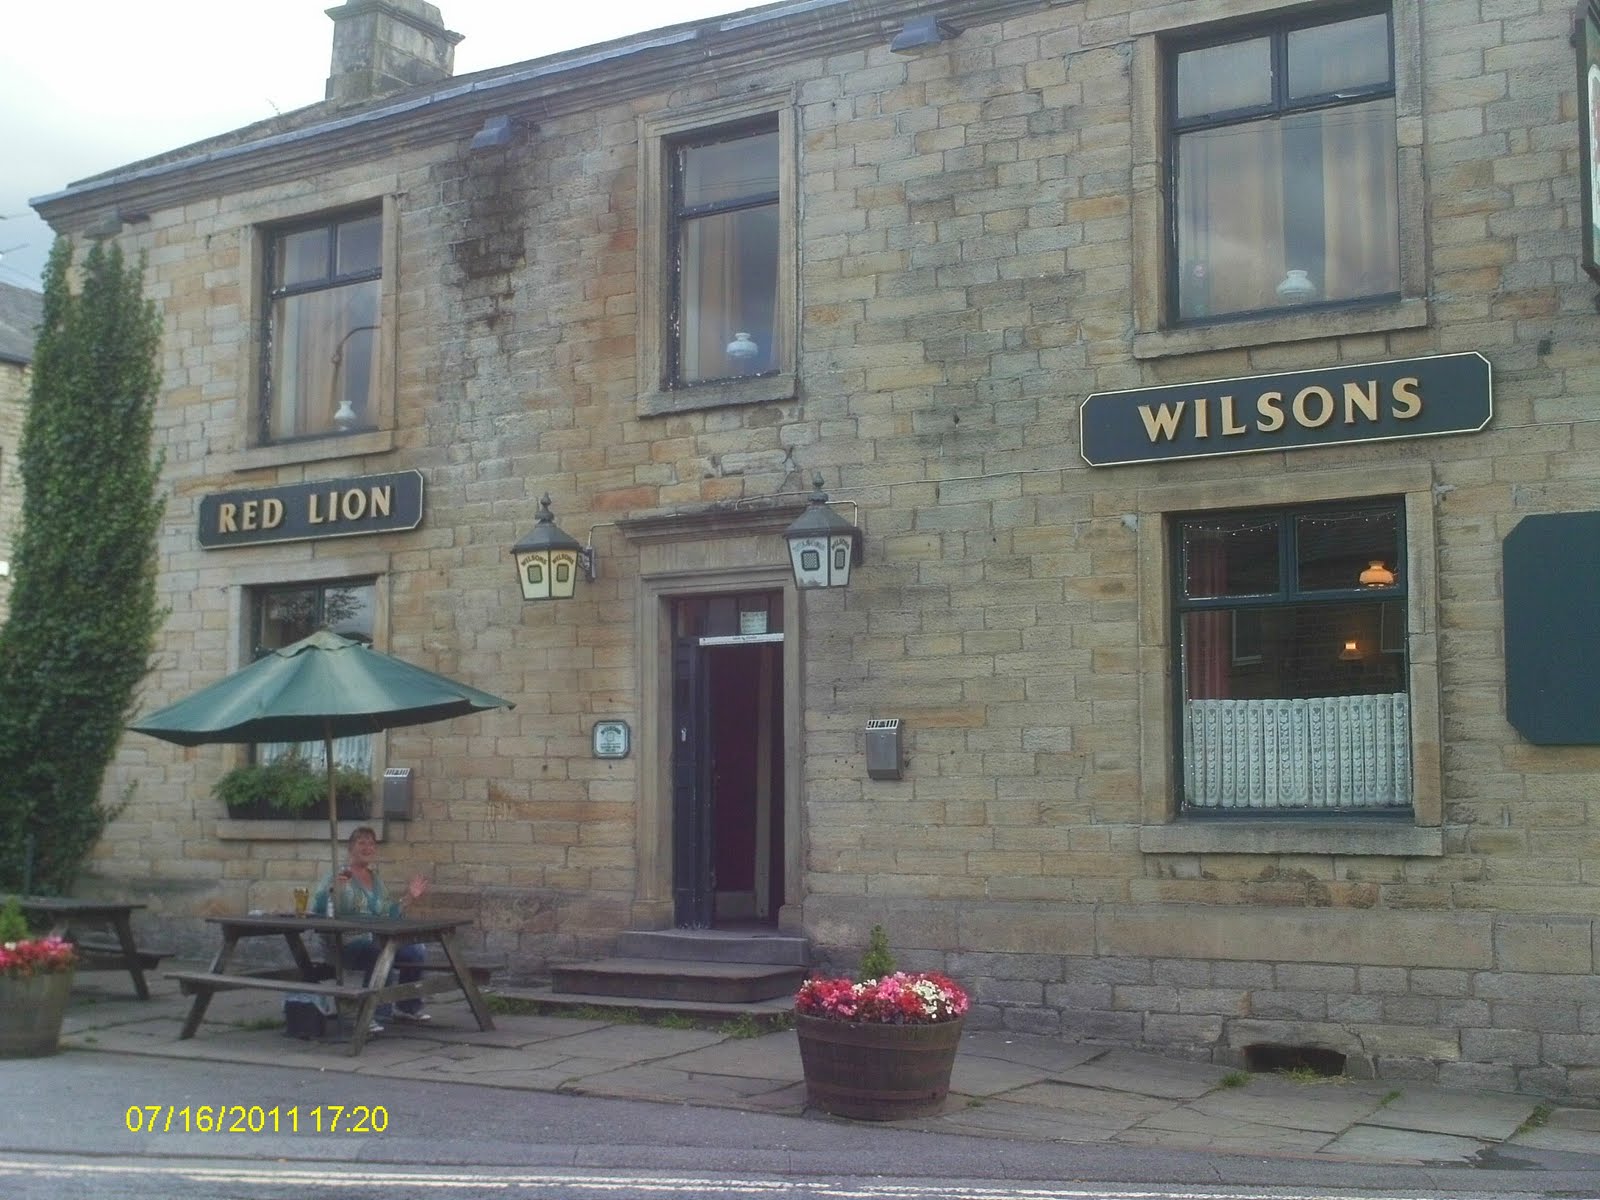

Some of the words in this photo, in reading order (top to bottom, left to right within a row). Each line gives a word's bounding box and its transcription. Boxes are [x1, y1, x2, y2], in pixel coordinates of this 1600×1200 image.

[1137, 377, 1423, 443] WILSONS
[218, 497, 284, 534] RED
[308, 485, 392, 525] LION
